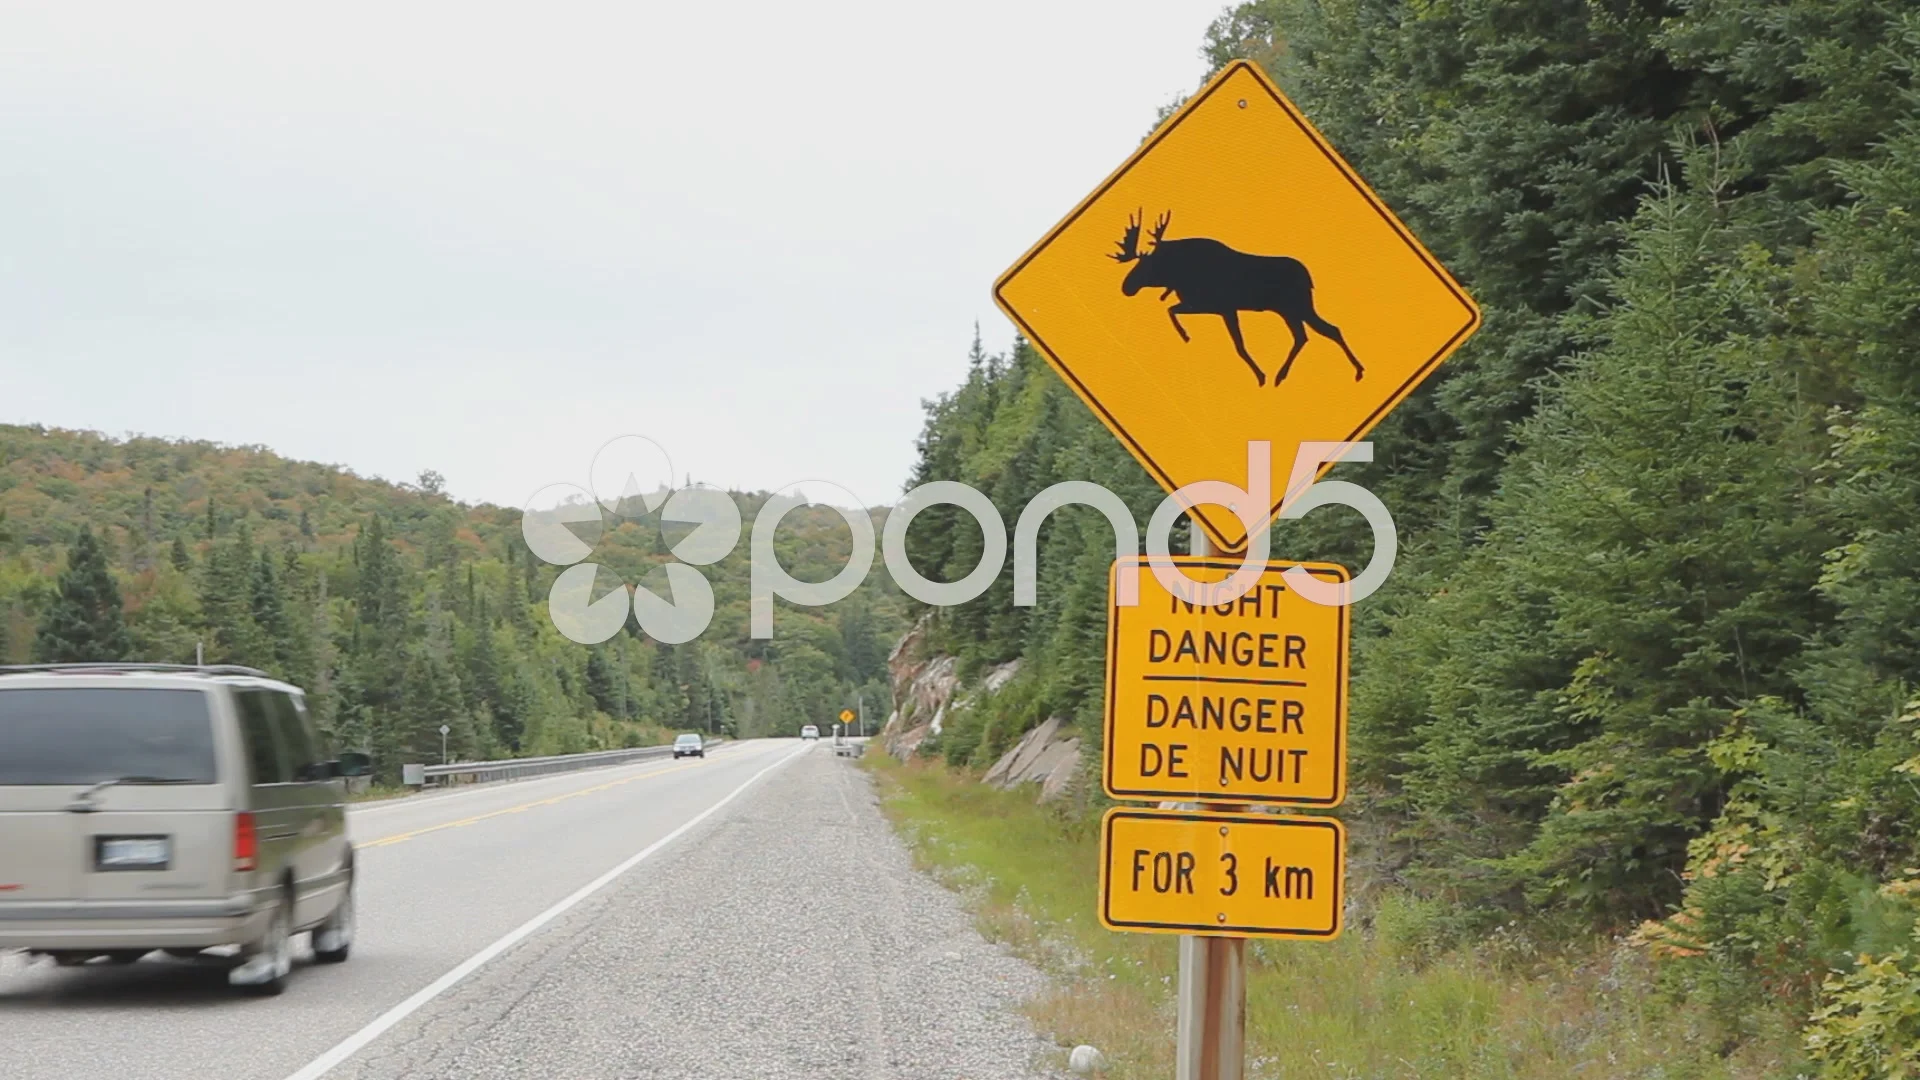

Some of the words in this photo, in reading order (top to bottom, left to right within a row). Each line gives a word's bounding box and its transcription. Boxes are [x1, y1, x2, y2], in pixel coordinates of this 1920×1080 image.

[1171, 580, 1286, 618] NIGHT
[1148, 629, 1306, 669] DANGER
[1146, 695, 1304, 734] DANGER
[1140, 743, 1189, 778] DE
[1220, 746, 1309, 784] NUIT
[1132, 850, 1195, 895] FOR
[1219, 852, 1239, 897] 3
[1264, 856, 1314, 900] km
